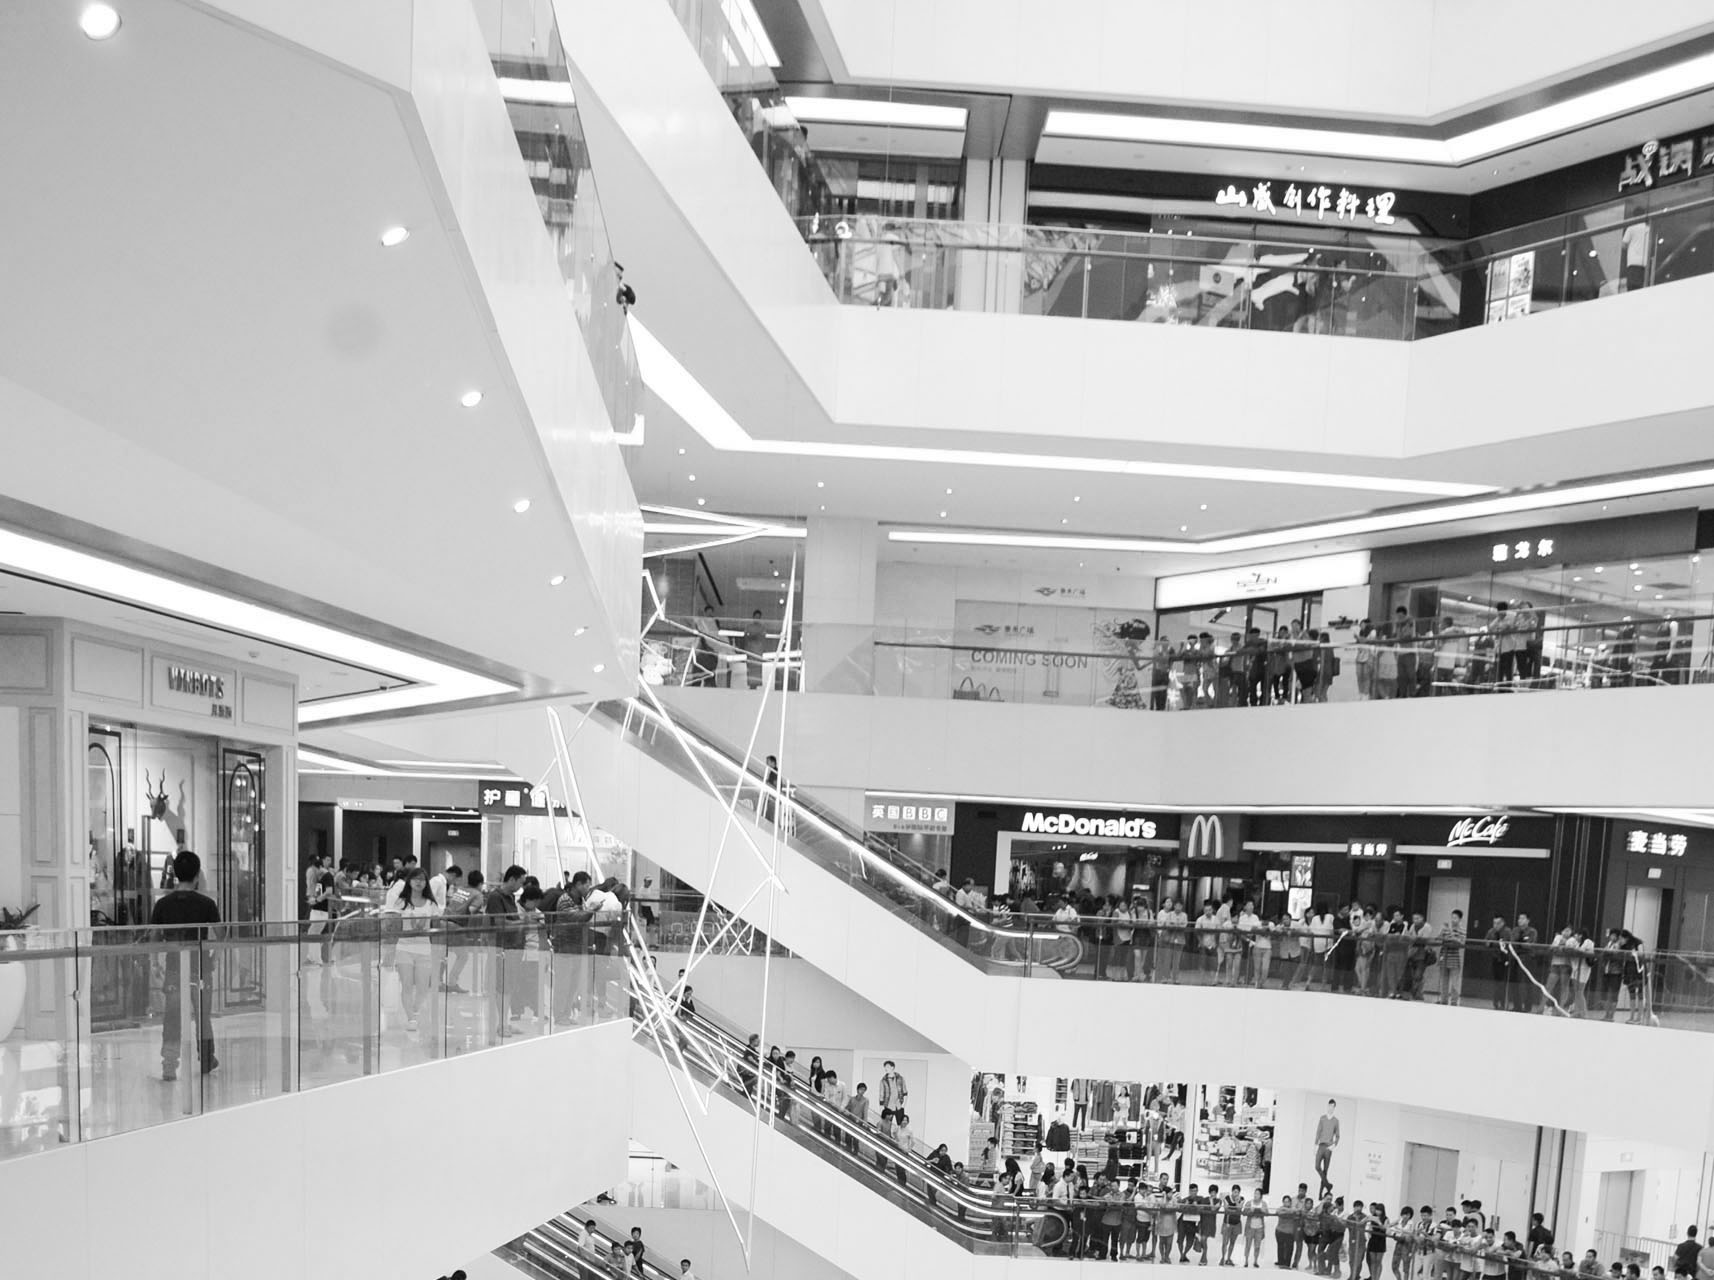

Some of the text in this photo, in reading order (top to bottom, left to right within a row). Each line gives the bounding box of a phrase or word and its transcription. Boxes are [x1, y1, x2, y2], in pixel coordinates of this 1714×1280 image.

[971, 650, 1036, 666] COMING
[1021, 812, 1157, 839] McDonald's
[1626, 830, 1687, 857] 麦当劳
